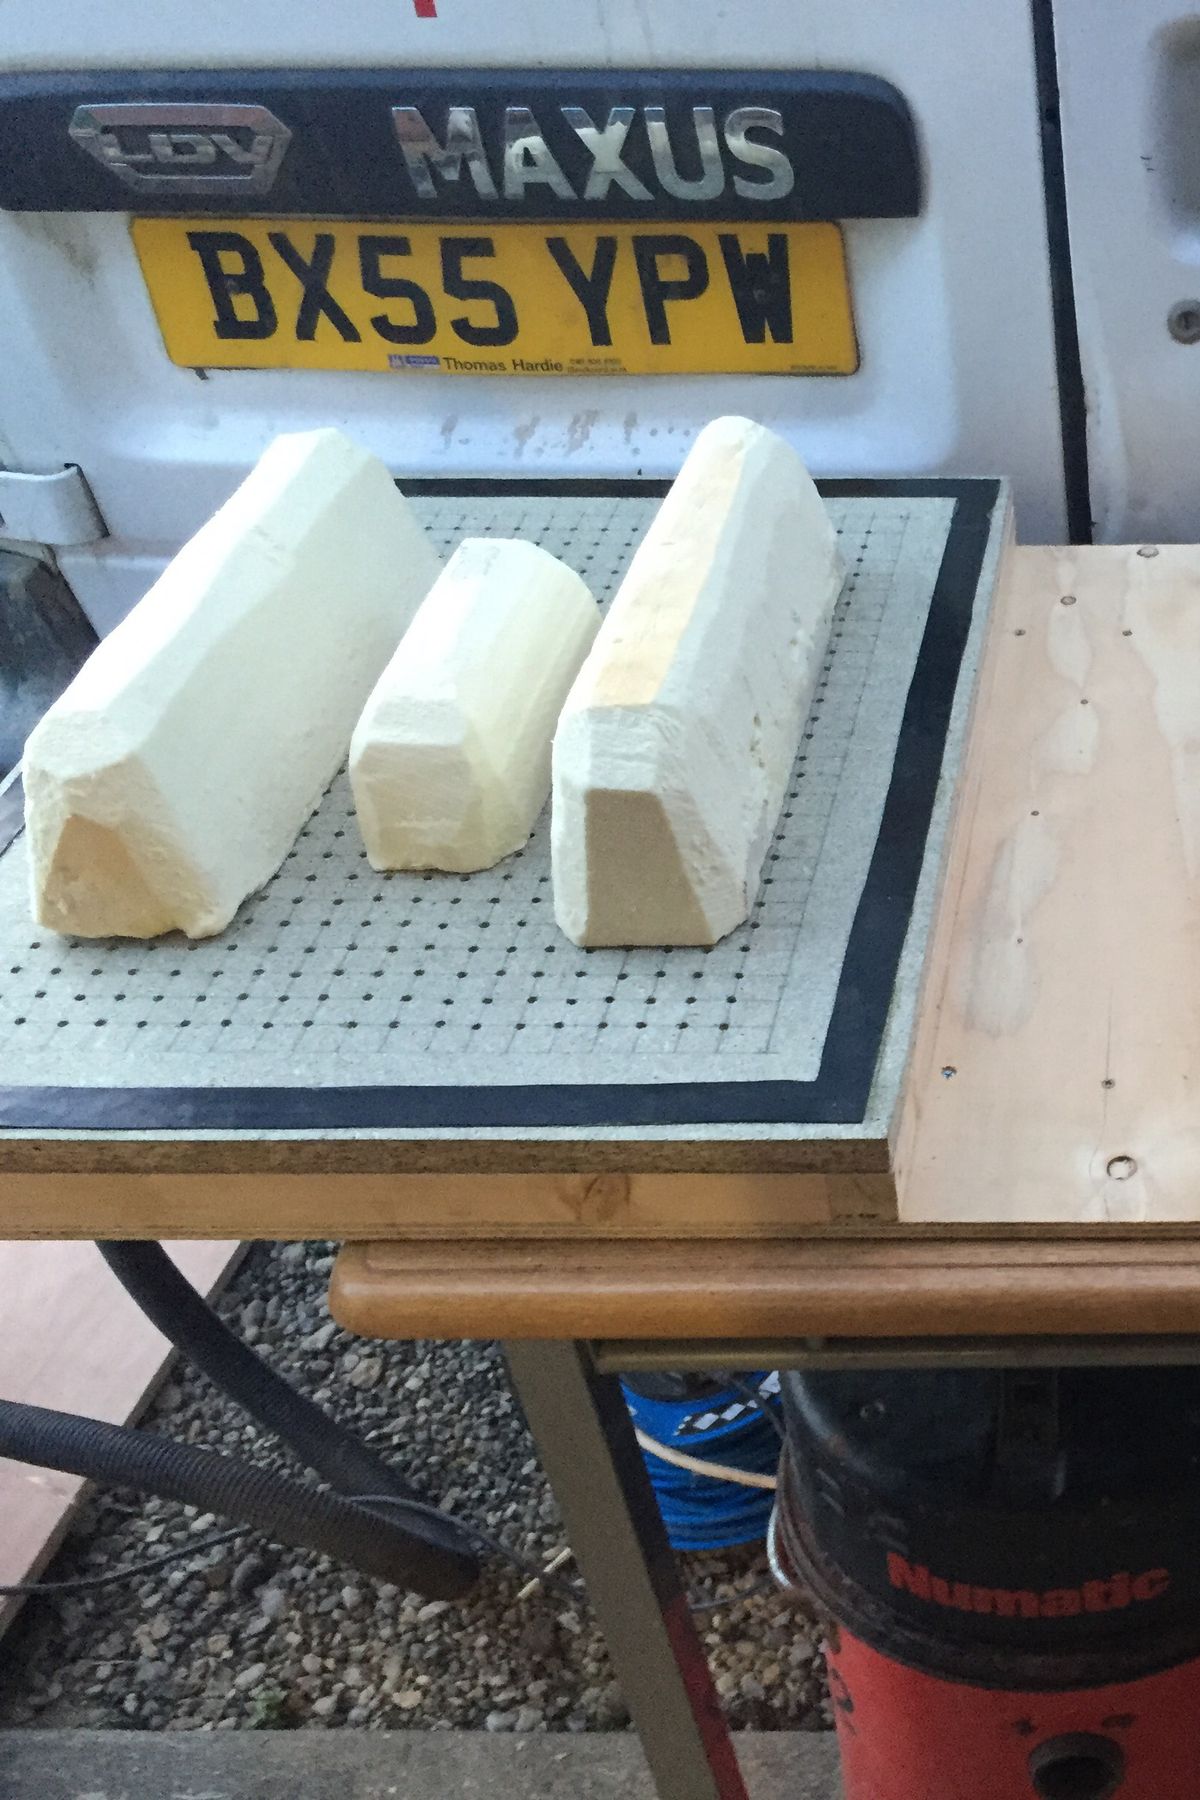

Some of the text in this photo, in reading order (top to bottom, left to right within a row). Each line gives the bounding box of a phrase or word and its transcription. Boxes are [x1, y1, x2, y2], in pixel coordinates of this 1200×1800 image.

[391, 106, 796, 201] MAXUS
[189, 231, 795, 347] BX55 YPW
[442, 356, 507, 372] Thomas
[511, 358, 563, 373] Hardie
[886, 1551, 1171, 1618] Numatic
